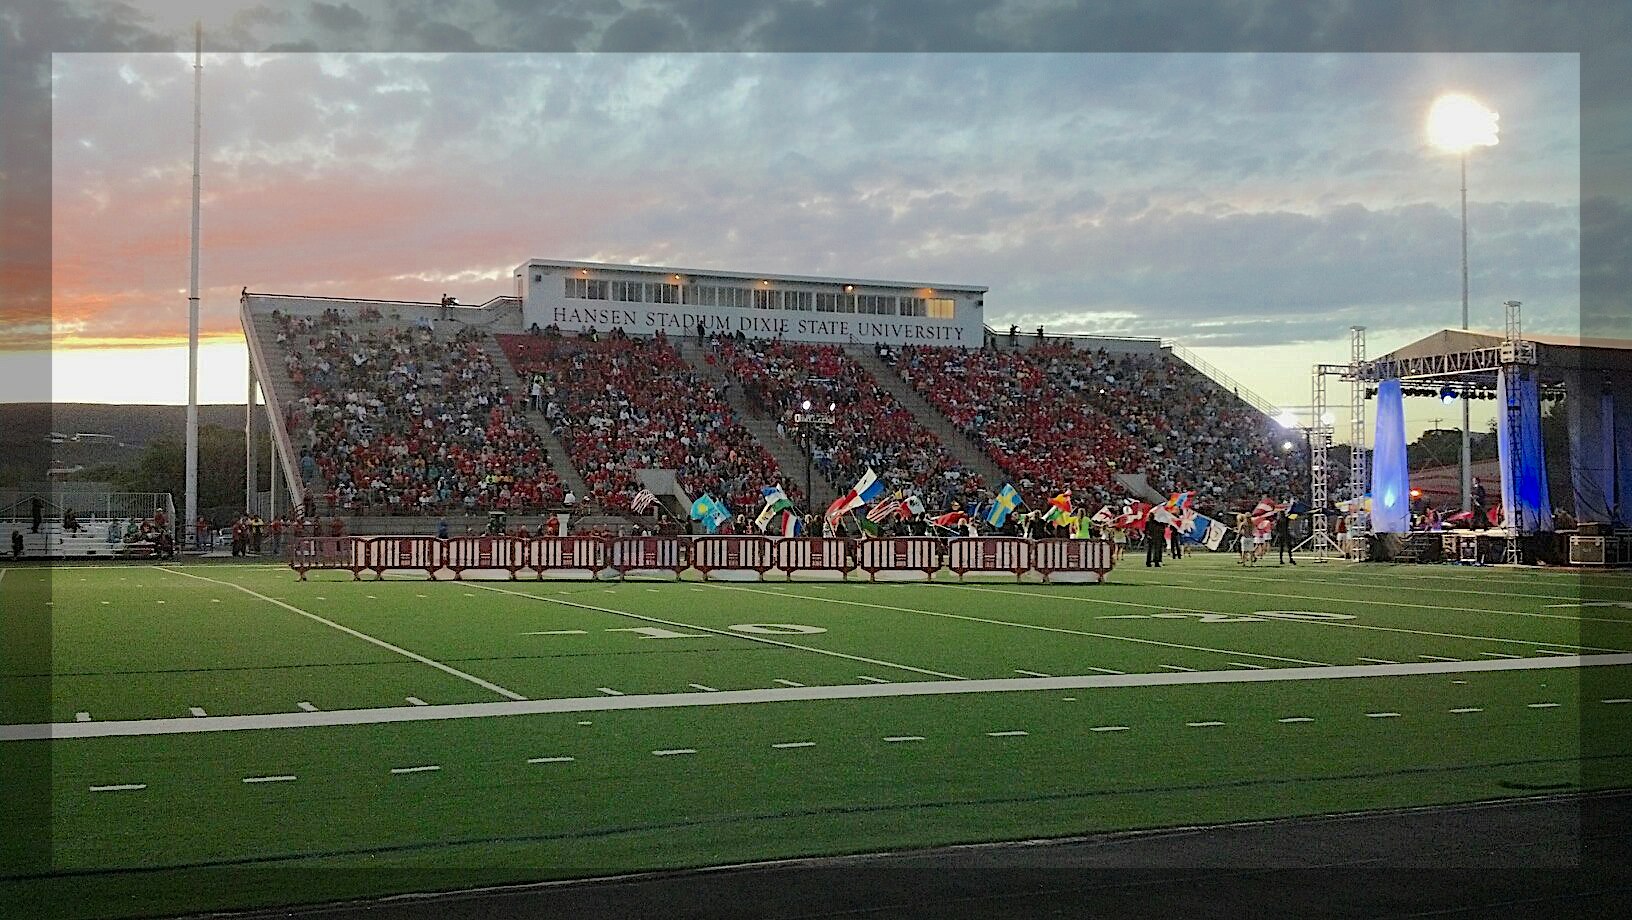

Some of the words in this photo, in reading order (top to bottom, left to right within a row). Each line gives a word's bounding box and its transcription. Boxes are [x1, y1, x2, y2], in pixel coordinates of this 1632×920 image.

[554, 307, 636, 325] HANSEN
[645, 312, 729, 330] STADIUM
[740, 316, 789, 333] DIXIE
[798, 319, 849, 336] STATE
[858, 322, 964, 341] UNIVERSITY
